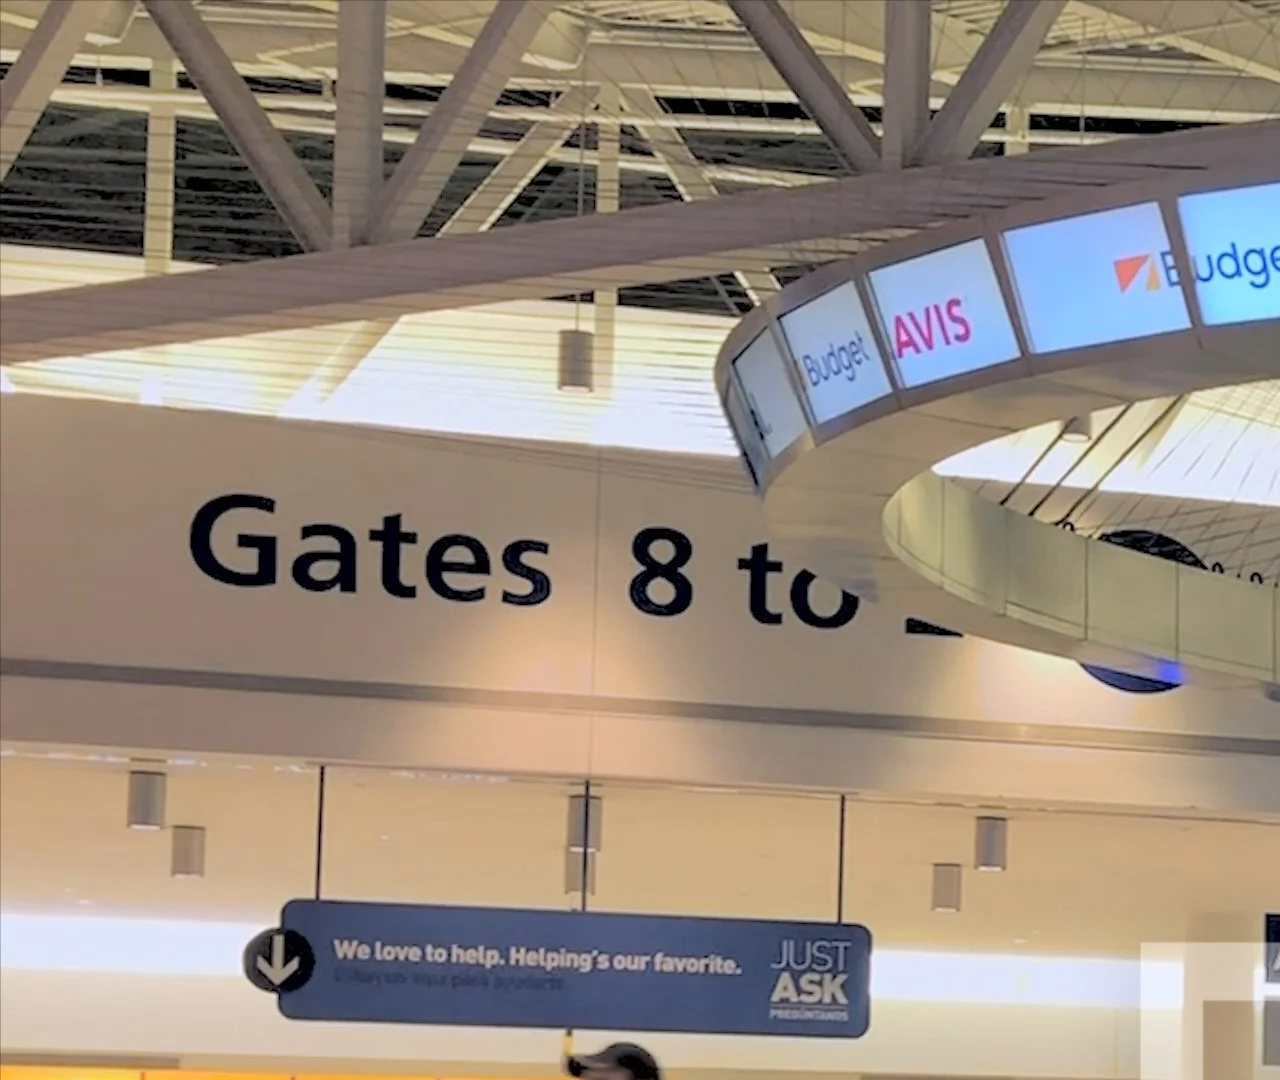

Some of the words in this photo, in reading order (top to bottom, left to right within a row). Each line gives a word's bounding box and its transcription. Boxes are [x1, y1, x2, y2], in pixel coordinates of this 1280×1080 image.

[893, 297, 972, 360] AVIS
[802, 330, 872, 389] Budget
[188, 491, 553, 608] Gates
[627, 525, 695, 618] 8
[736, 540, 859, 631] to
[332, 938, 371, 962] We
[374, 941, 422, 964] love
[425, 943, 449, 964] to
[450, 943, 506, 970] help.
[508, 945, 610, 973] Helping's
[612, 954, 650, 972] our
[654, 951, 743, 976] favorite.
[769, 939, 853, 971] JUST
[769, 971, 850, 1005] ASK
